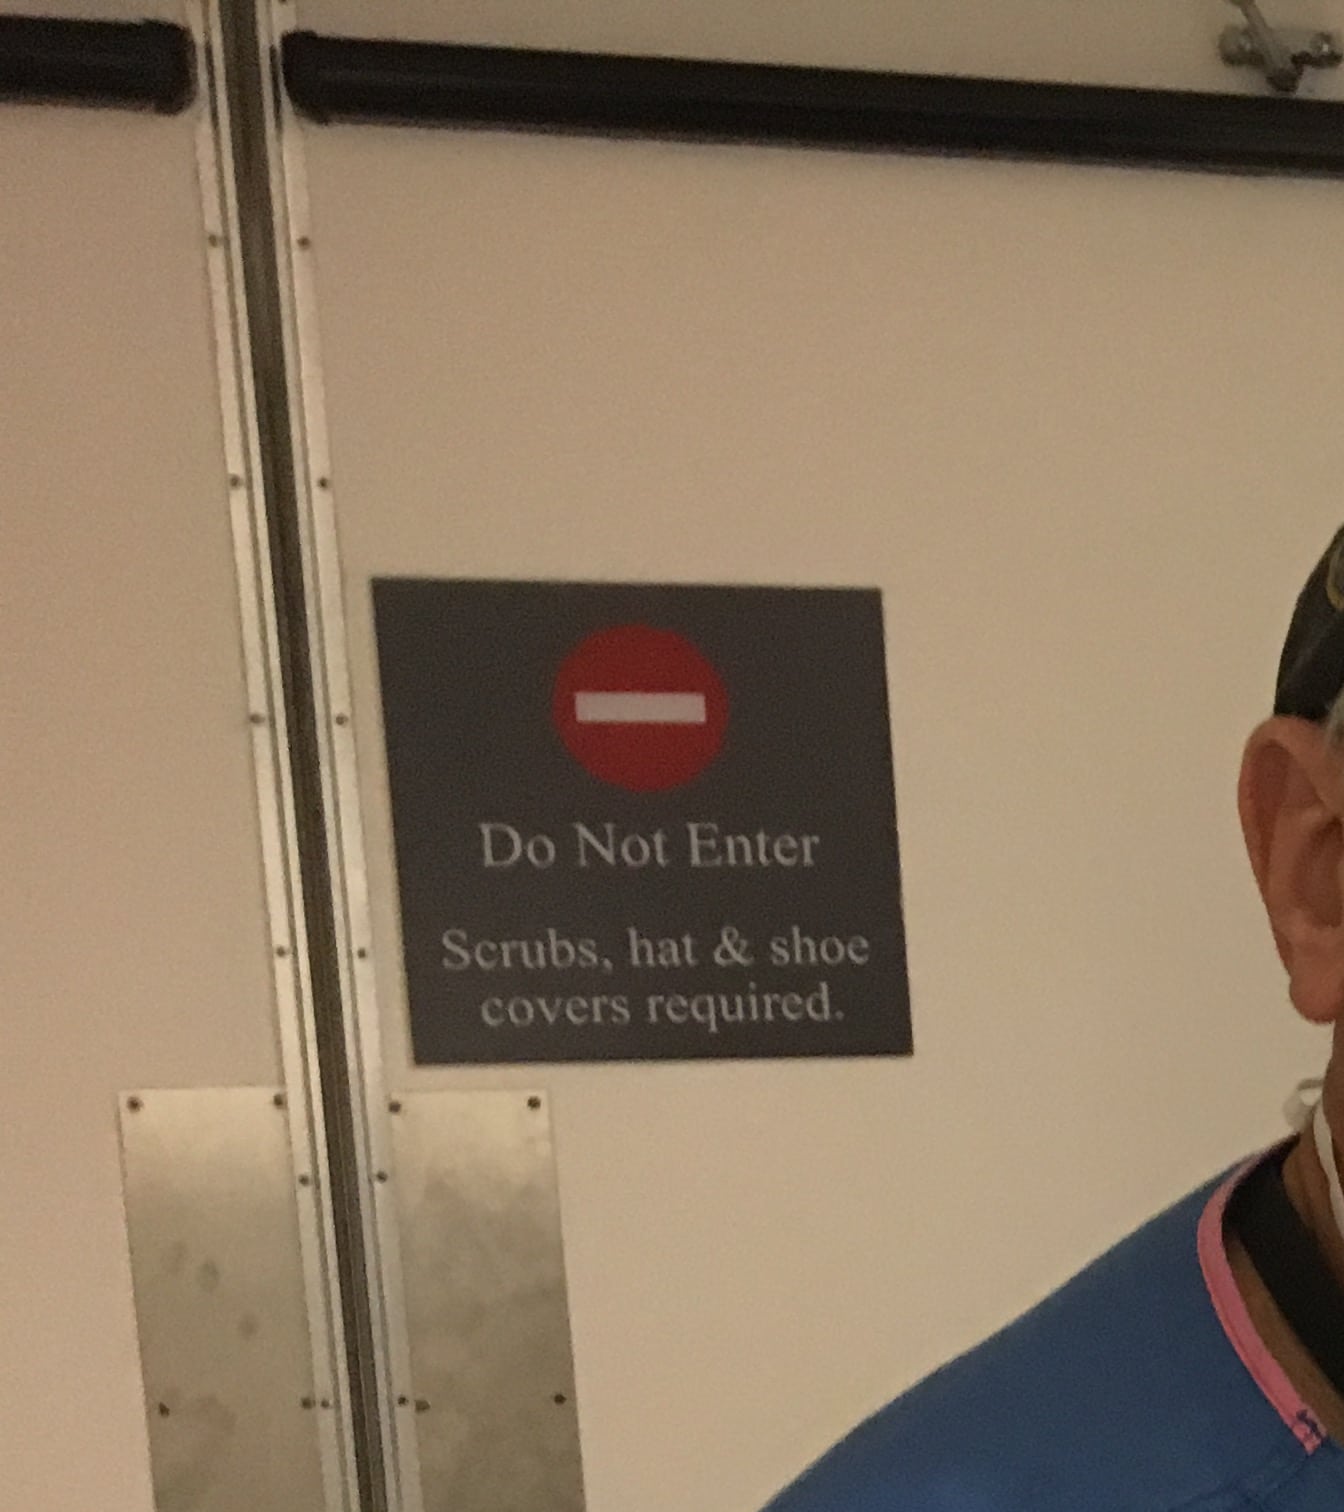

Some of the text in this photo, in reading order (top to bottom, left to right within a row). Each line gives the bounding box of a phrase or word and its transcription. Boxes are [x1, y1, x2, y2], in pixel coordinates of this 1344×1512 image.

[478, 822, 820, 870] Do Not Enter
[440, 926, 871, 974] Scrubs, hat & shoe
[480, 982, 845, 1034] covers required.
